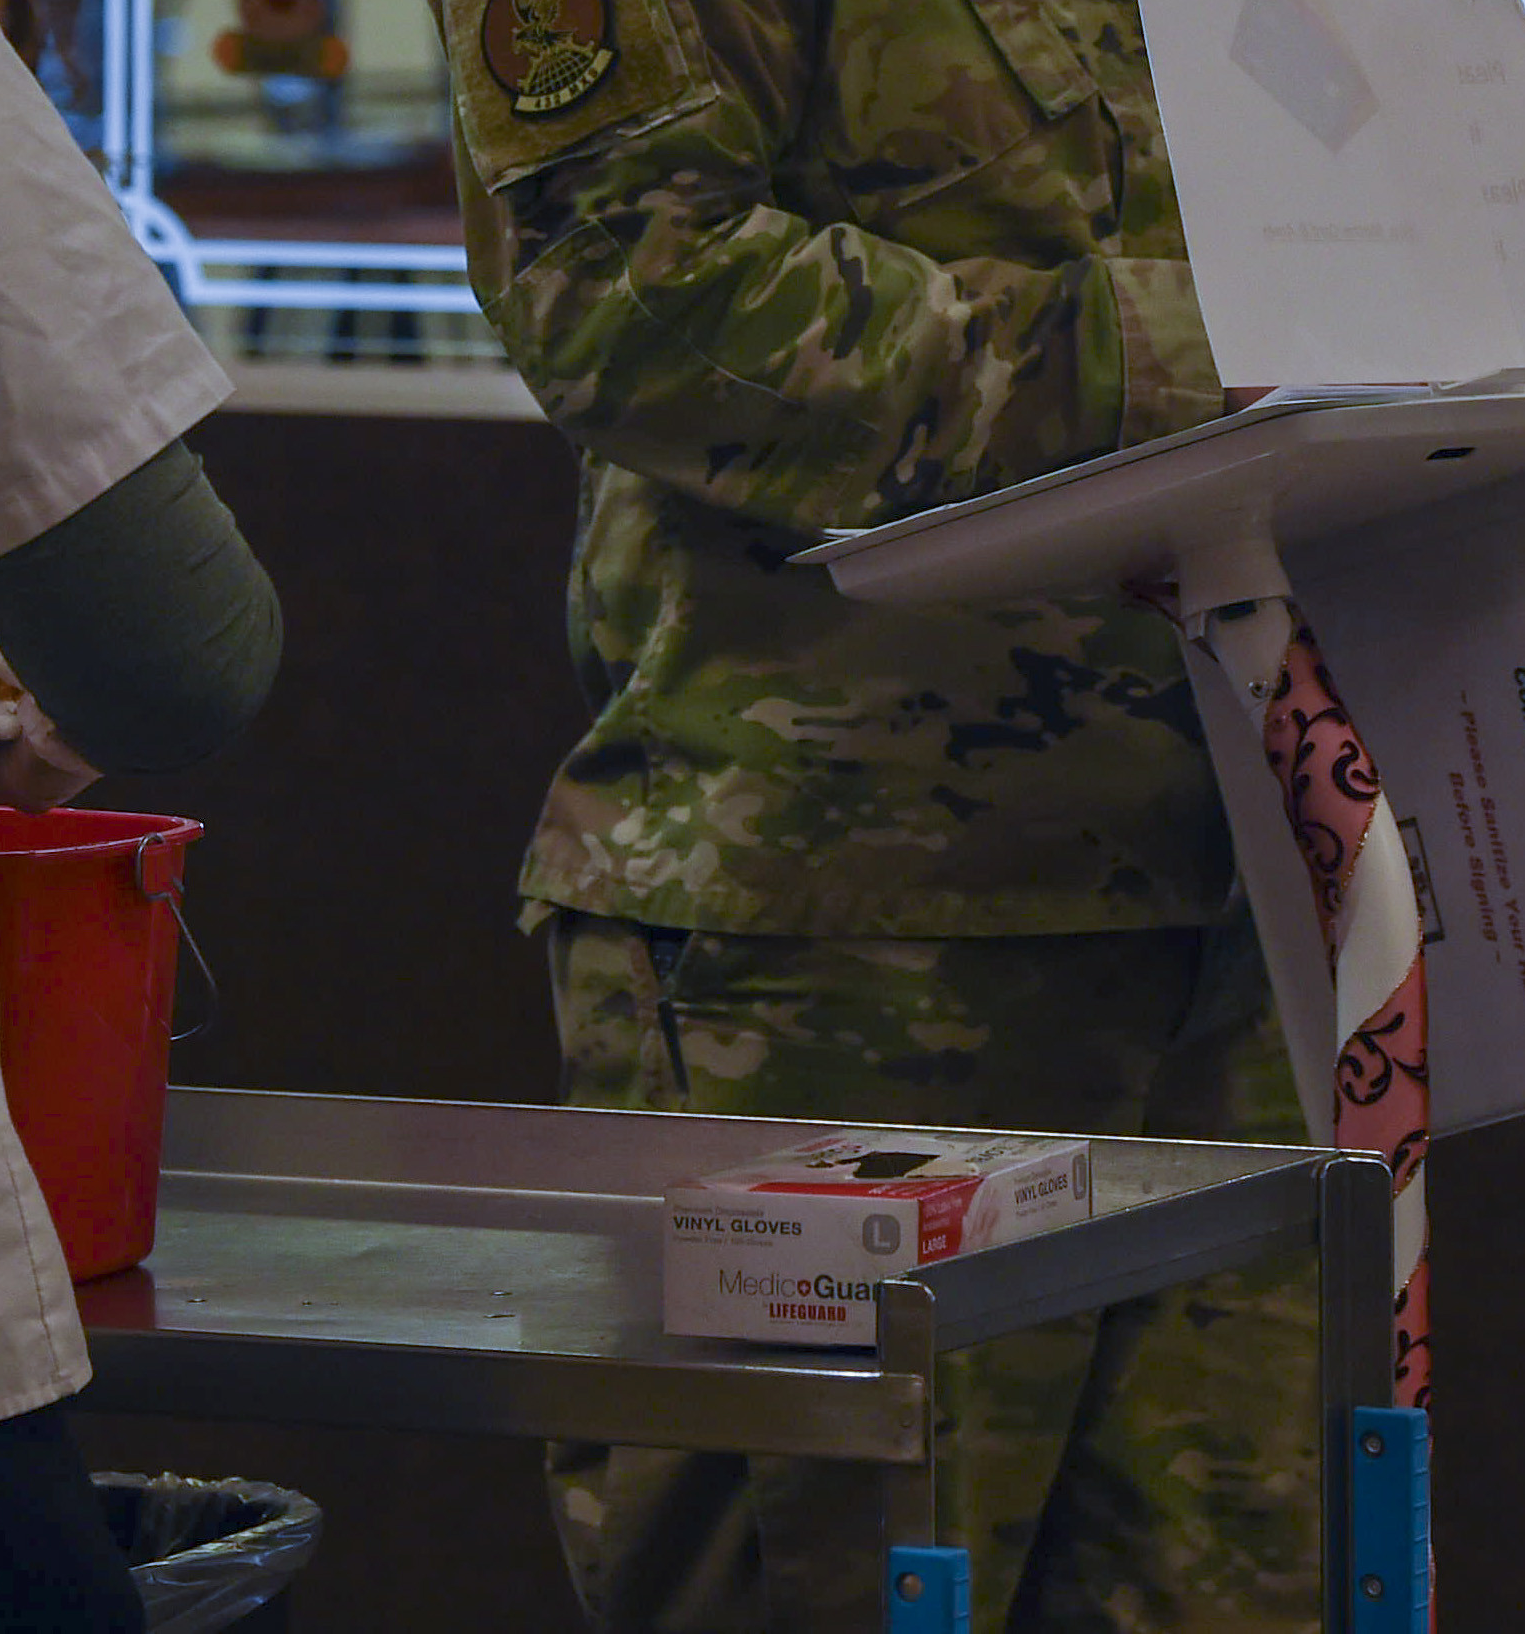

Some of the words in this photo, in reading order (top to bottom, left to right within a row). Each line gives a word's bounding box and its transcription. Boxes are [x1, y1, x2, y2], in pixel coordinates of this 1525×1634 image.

[1459, 711, 1490, 789] Please
[1478, 796, 1513, 891] Sanitize
[1447, 771, 1478, 849] Before
[1468, 856, 1499, 943] Signing
[1015, 1184, 1037, 1205] VINYL
[1038, 1173, 1068, 1197] GLOVES
[673, 1216, 726, 1232] VINYL
[731, 1218, 802, 1236] GLOVES
[872, 1221, 891, 1248] L
[922, 1234, 947, 1255] LARGE
[814, 1273, 882, 1301] Guar
[768, 1302, 847, 1322] LIFEGUARD
